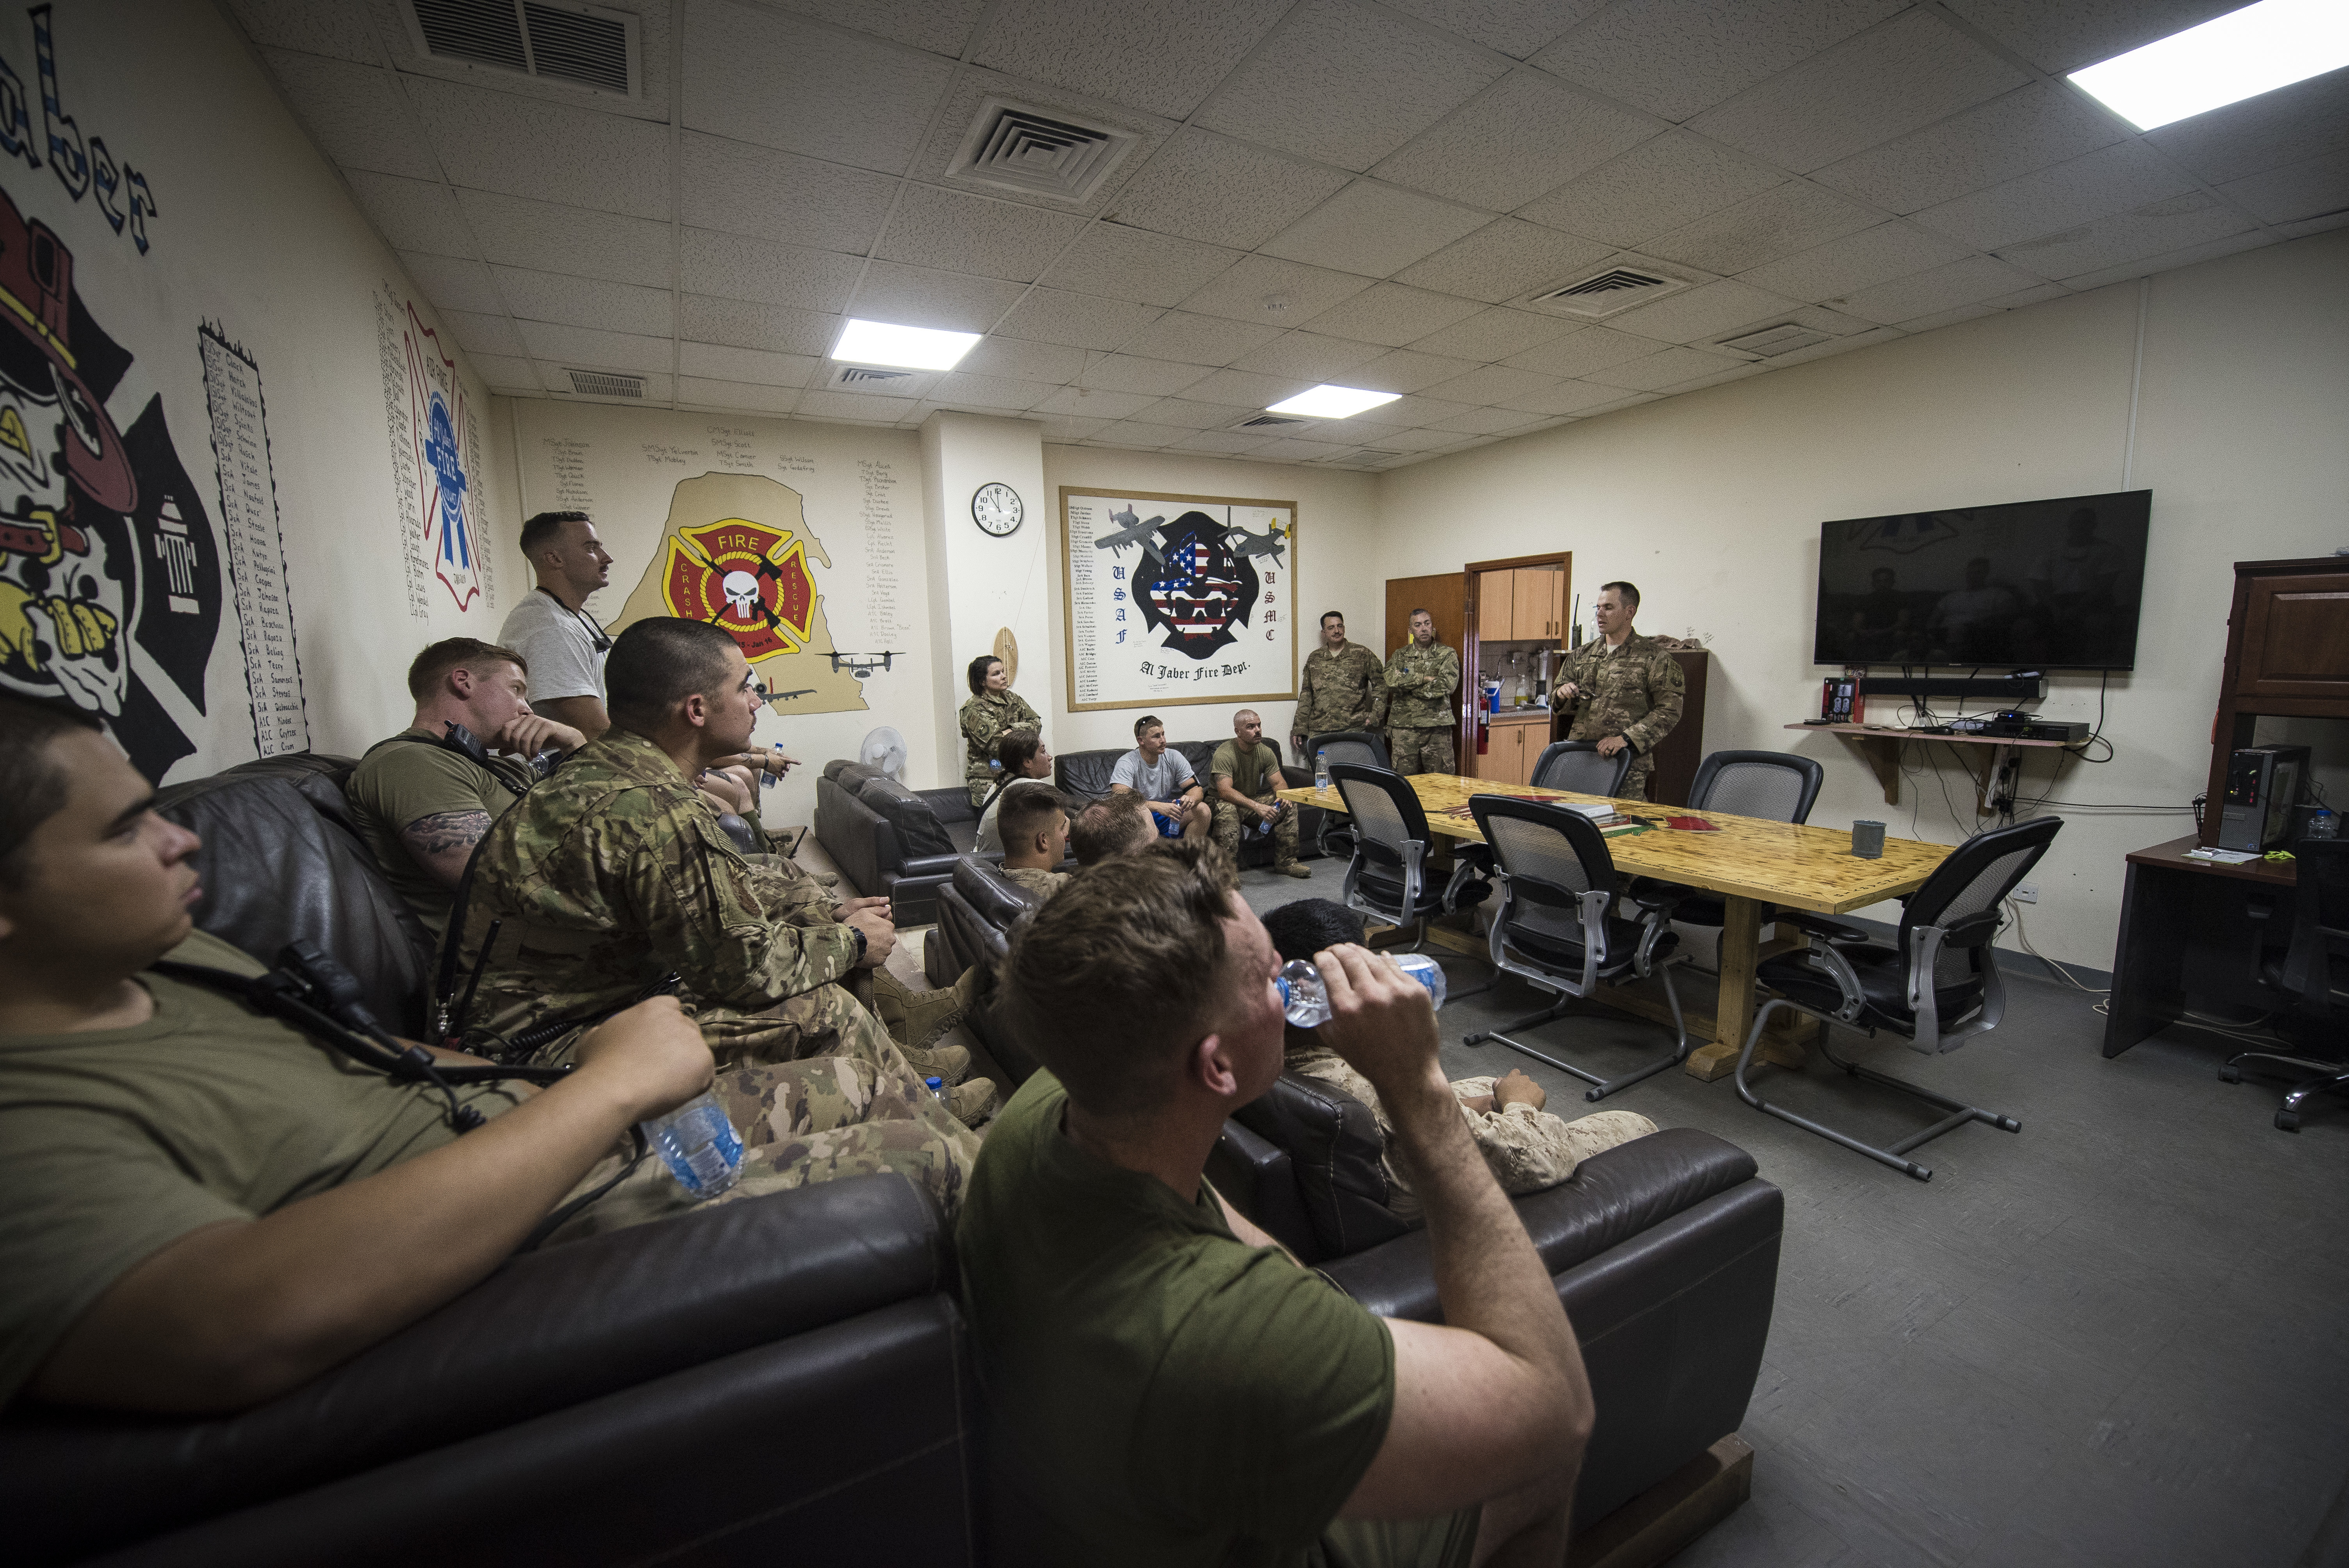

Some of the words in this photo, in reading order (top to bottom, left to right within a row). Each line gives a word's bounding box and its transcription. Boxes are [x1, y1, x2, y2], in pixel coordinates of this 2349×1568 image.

[426, 354, 436, 381] AIR
[436, 365, 449, 394] FORCE
[417, 411, 428, 486] ARMY
[543, 438, 562, 448] MSgt
[564, 438, 590, 448] Johnson
[642, 444, 667, 456] SMSgt
[711, 438, 732, 449] SMSgt
[734, 440, 751, 448] Scott
[221, 448, 232, 463] SrA
[435, 445, 457, 482] FIRE
[646, 454, 661, 464] TSgt
[665, 456, 686, 466] Mobley
[719, 460, 733, 468] TSgt
[223, 464, 234, 479] SrA
[242, 473, 260, 490] James
[224, 479, 235, 493] SrA
[228, 509, 240, 523] SrA
[248, 518, 265, 532] Steele
[718, 534, 759, 551] FIRE
[235, 552, 246, 566] SrA
[237, 568, 248, 582] SrA
[255, 574, 272, 589] Cooper
[239, 583, 251, 597] SrA
[257, 588, 279, 602] Johnson
[681, 563, 692, 618] CRASH
[241, 598, 252, 611] SrA
[1112, 566, 1128, 644] USAF
[1264, 572, 1276, 641] USMC
[246, 628, 257, 641] SrA
[248, 643, 259, 655] SrA
[266, 644, 284, 660] Boling
[250, 656, 262, 669] SrA
[1140, 661, 1155, 675] Al
[1157, 665, 1190, 679] Jaber
[1193, 667, 1218, 681] Fire
[255, 686, 266, 698] SrA
[261, 730, 273, 742] A1C
